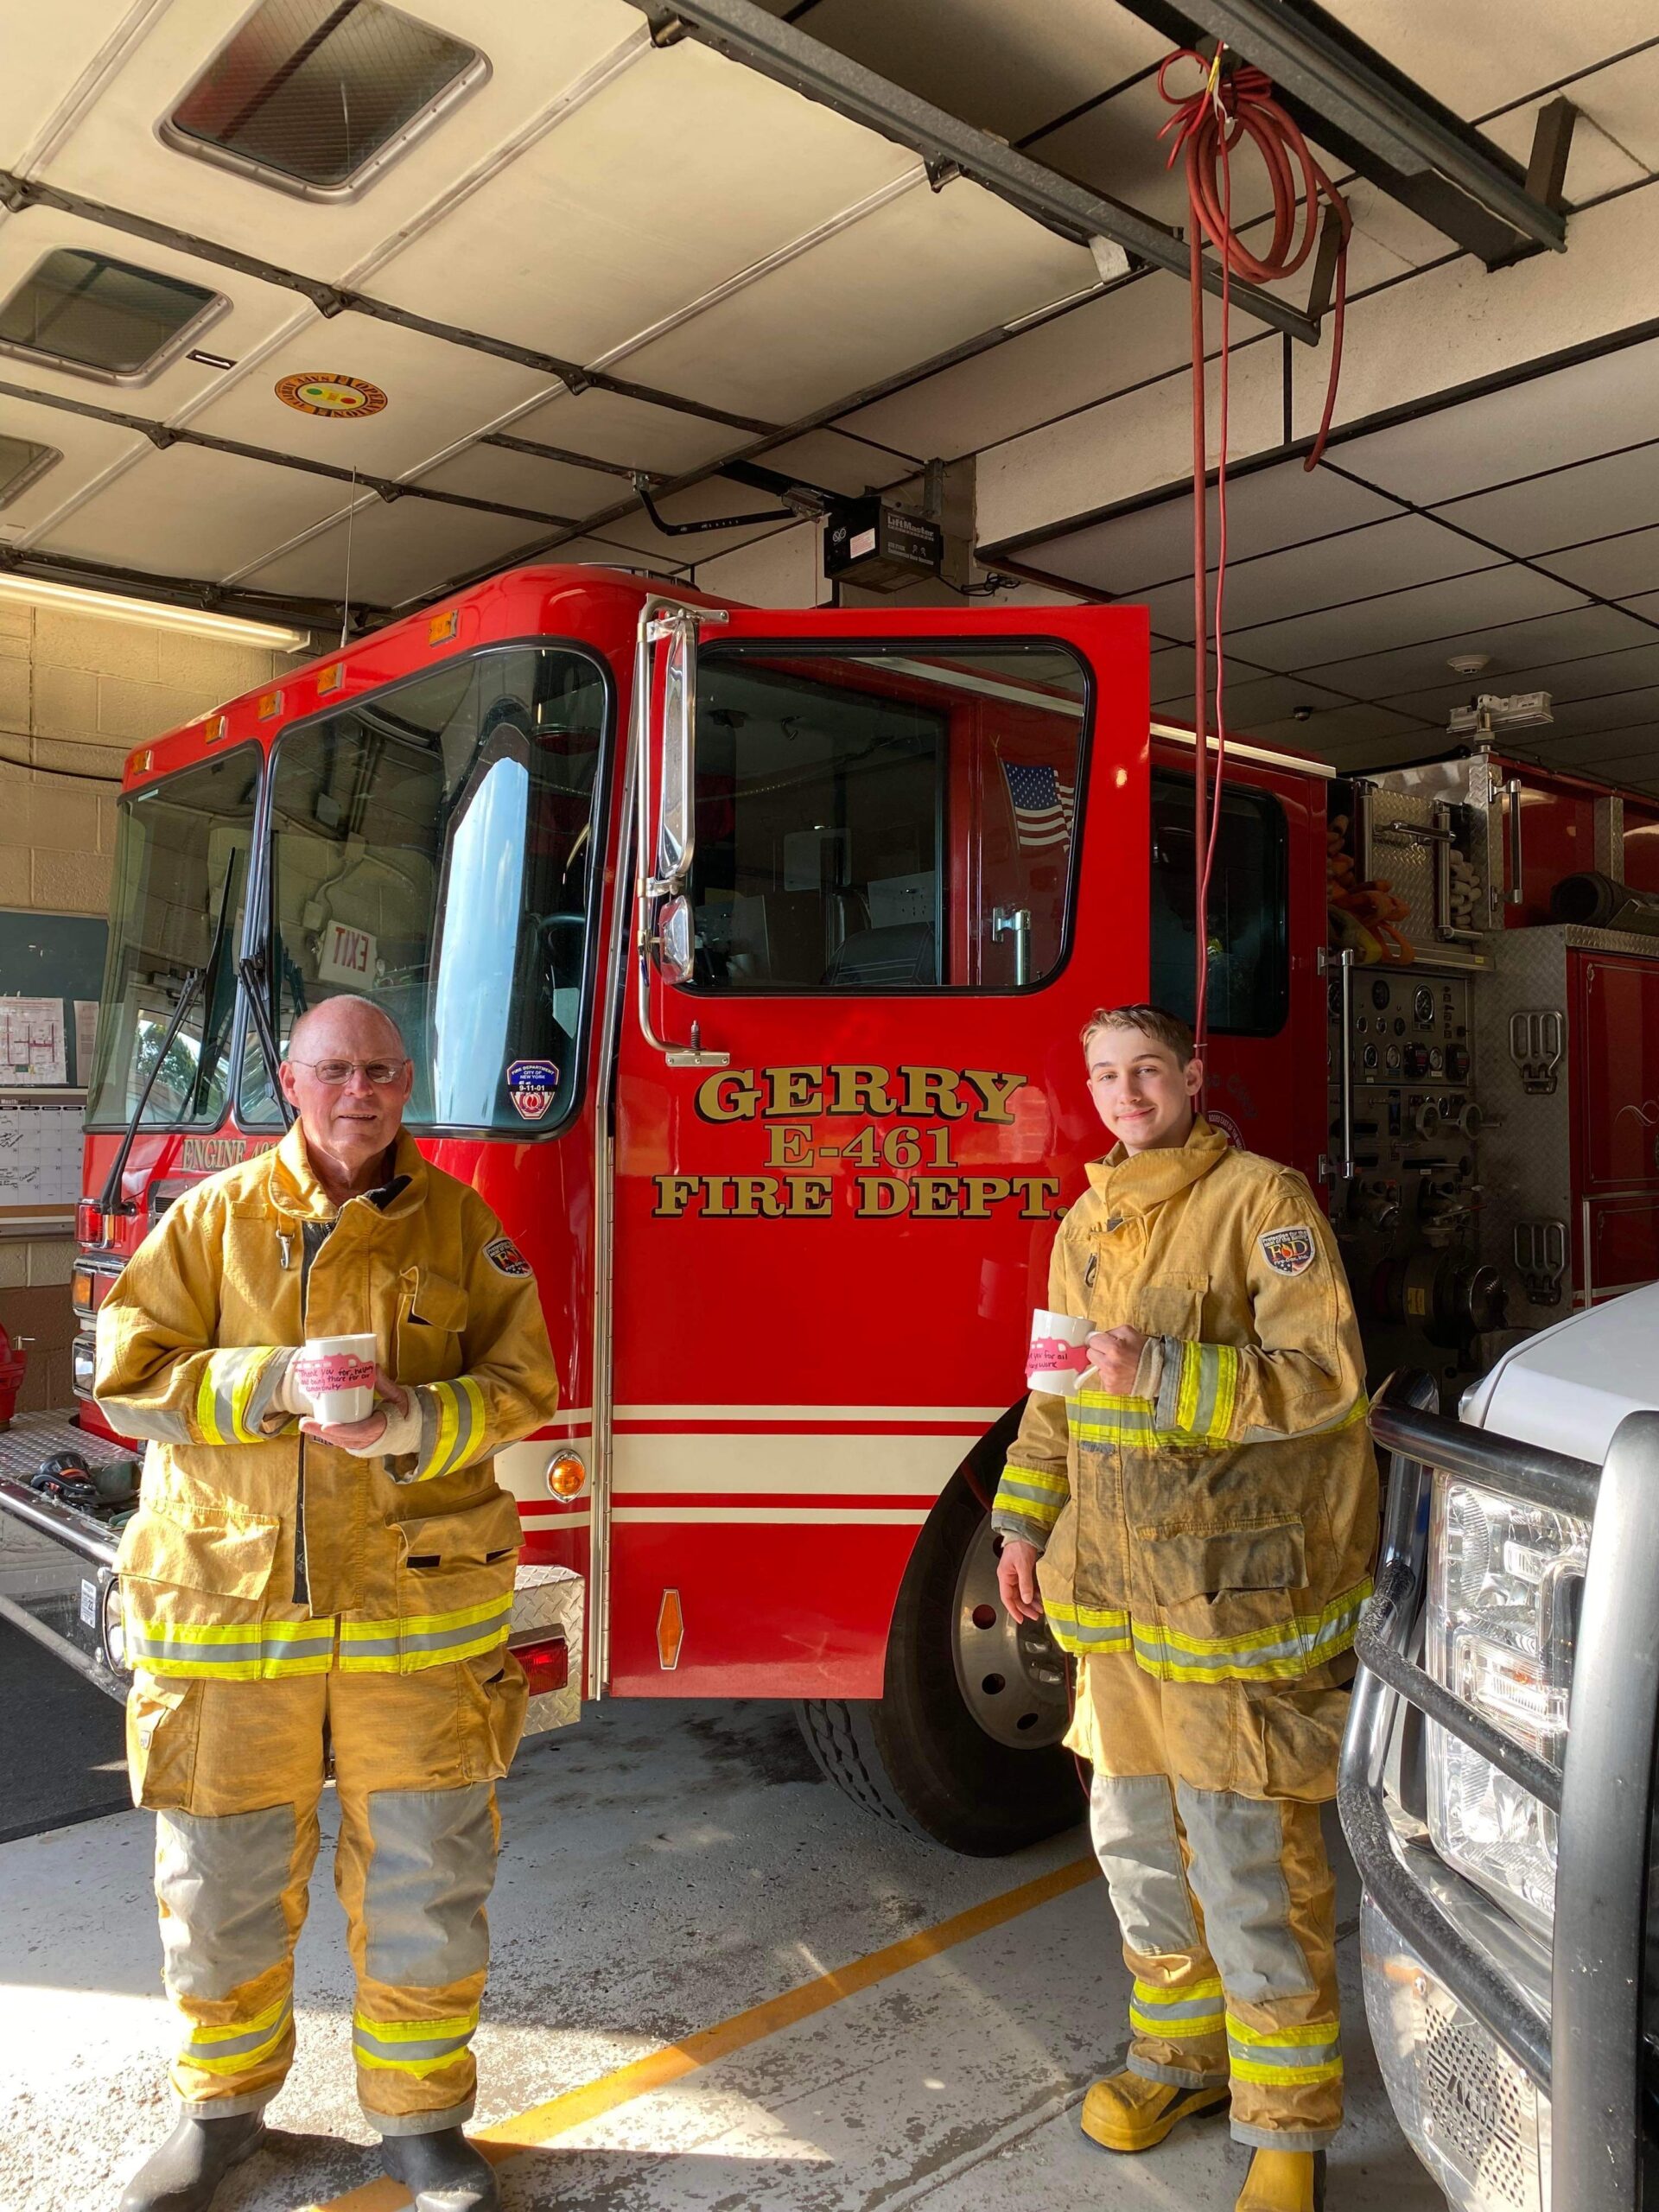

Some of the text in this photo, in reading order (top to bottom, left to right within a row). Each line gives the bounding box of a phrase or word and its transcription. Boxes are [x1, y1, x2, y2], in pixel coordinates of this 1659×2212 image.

[332, 382, 385, 417] OPERATION
[523, 1065, 555, 1075] DEPARTMENT
[695, 1064, 1027, 1123] GERRY
[182, 1138, 246, 1172] ENGINE
[763, 1124, 958, 1168] E-461
[651, 1174, 1070, 1220] FIRE DEPT.
